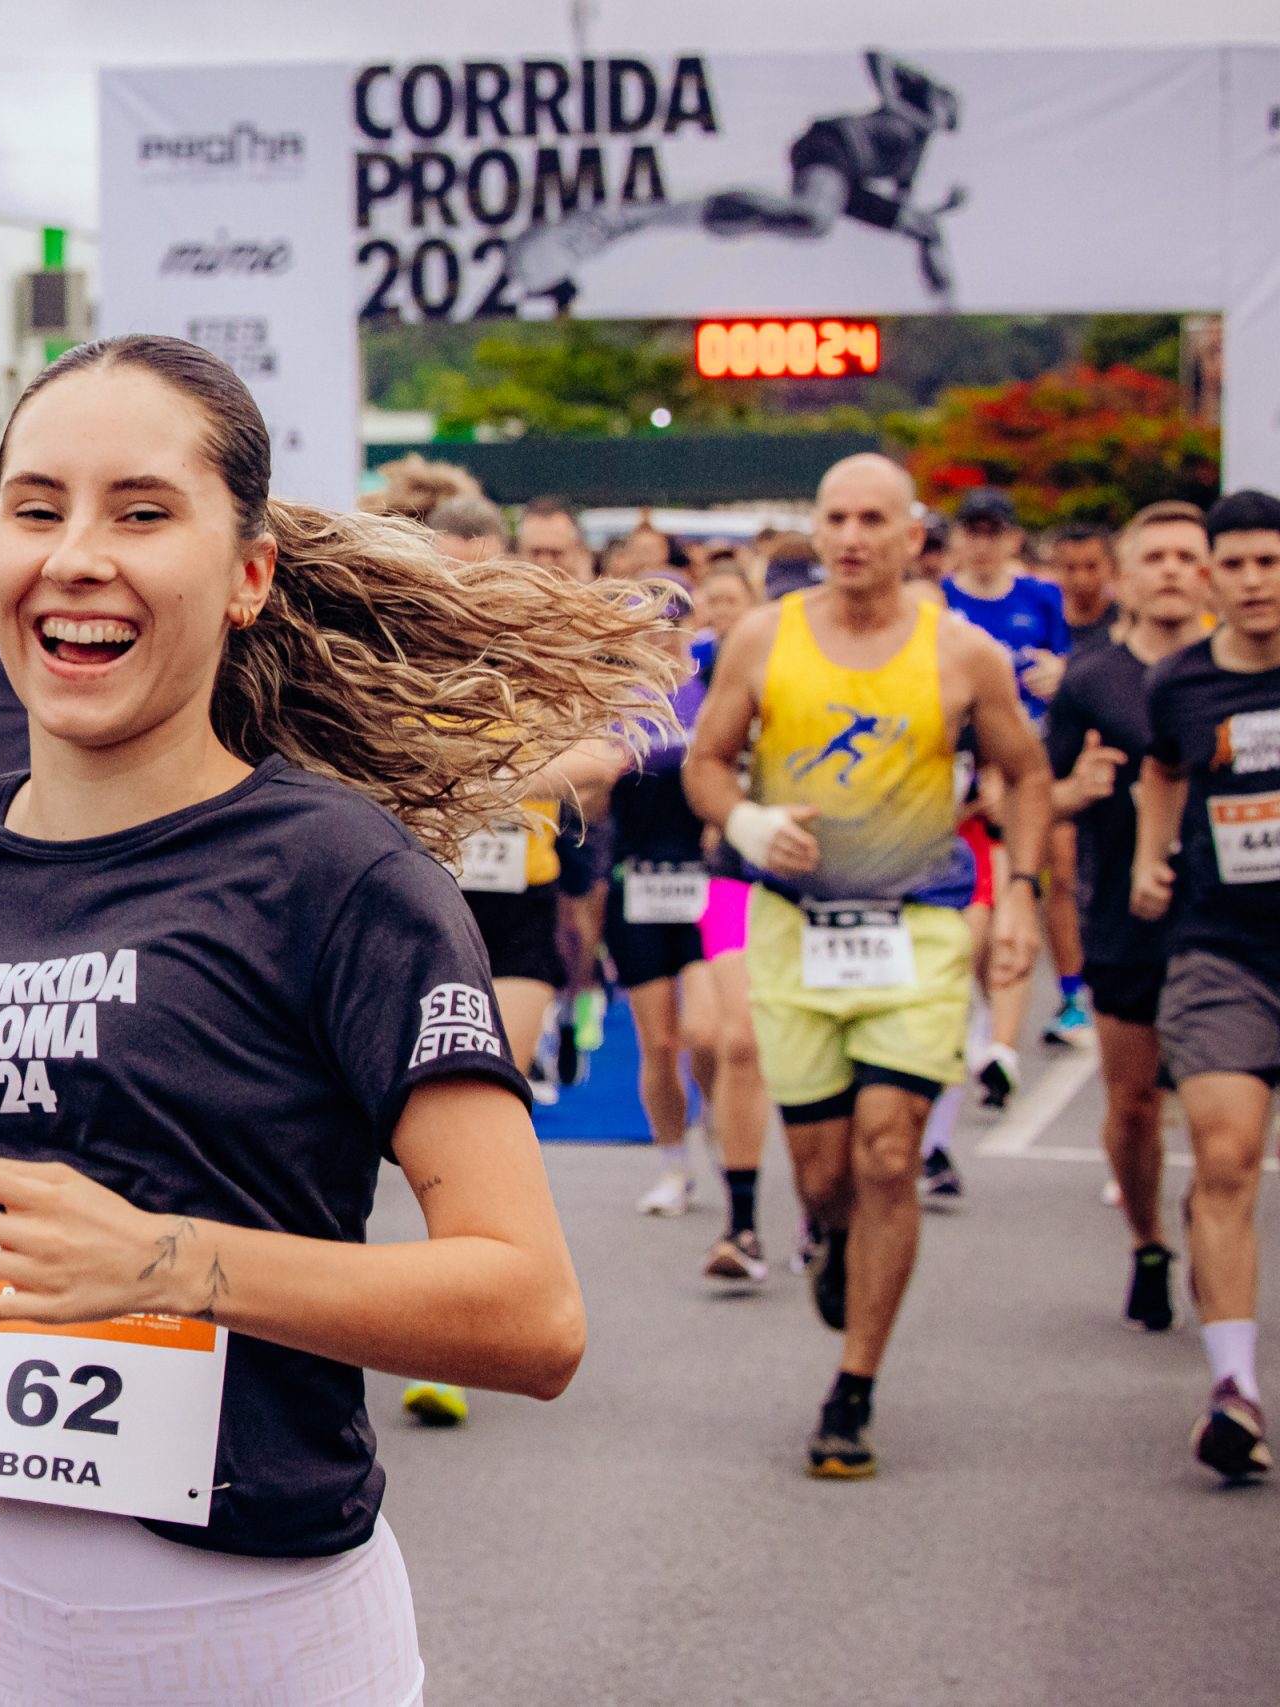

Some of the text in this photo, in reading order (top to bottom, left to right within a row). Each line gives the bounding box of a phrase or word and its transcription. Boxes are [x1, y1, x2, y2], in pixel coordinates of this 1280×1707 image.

[355, 57, 717, 140] CORRIDA
[356, 147, 666, 227] PROMA
[357, 238, 532, 319] 202
[428, 990, 487, 1024] SESI
